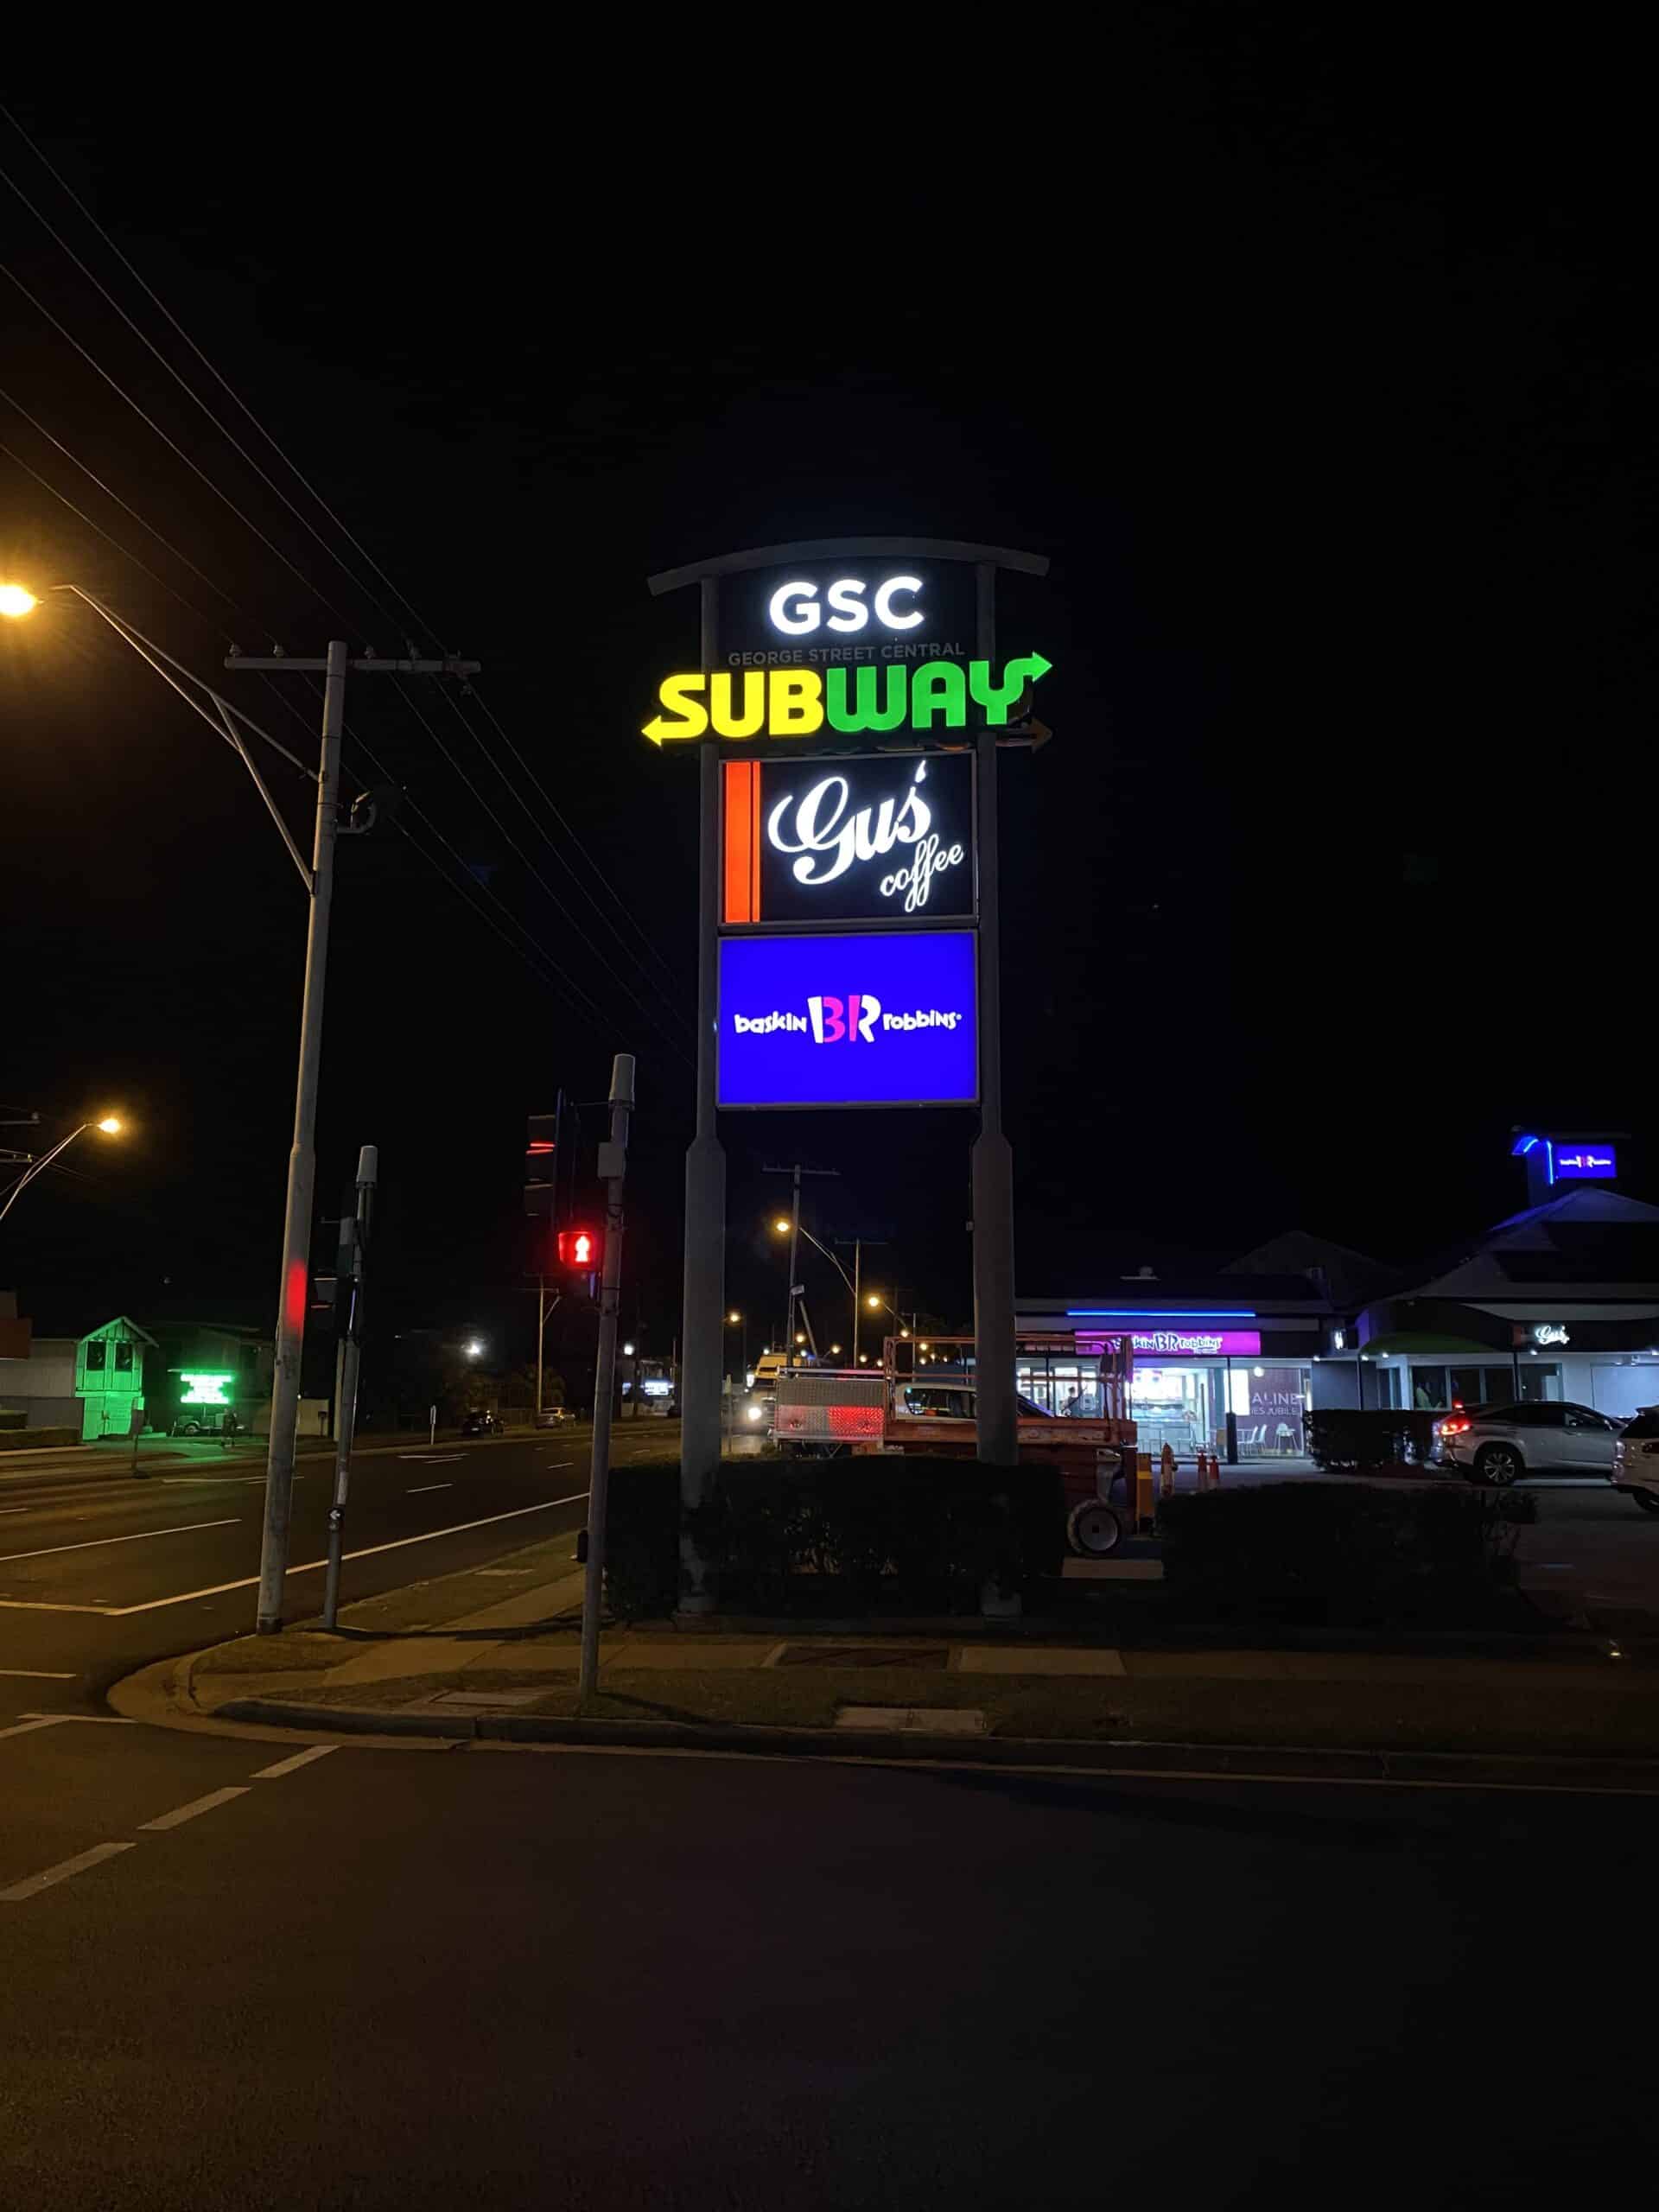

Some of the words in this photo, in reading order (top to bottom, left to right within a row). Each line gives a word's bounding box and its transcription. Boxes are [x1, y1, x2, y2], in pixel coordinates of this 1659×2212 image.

[770, 575, 925, 634] GSC
[728, 648, 803, 666] GEORGE
[808, 646, 874, 663] STREET
[880, 642, 966, 659] CENTRAL
[641, 651, 1053, 747] SUBWAY
[880, 833, 964, 913] coffee
[807, 994, 881, 1044] BR
[1154, 1333, 1179, 1352] BR
